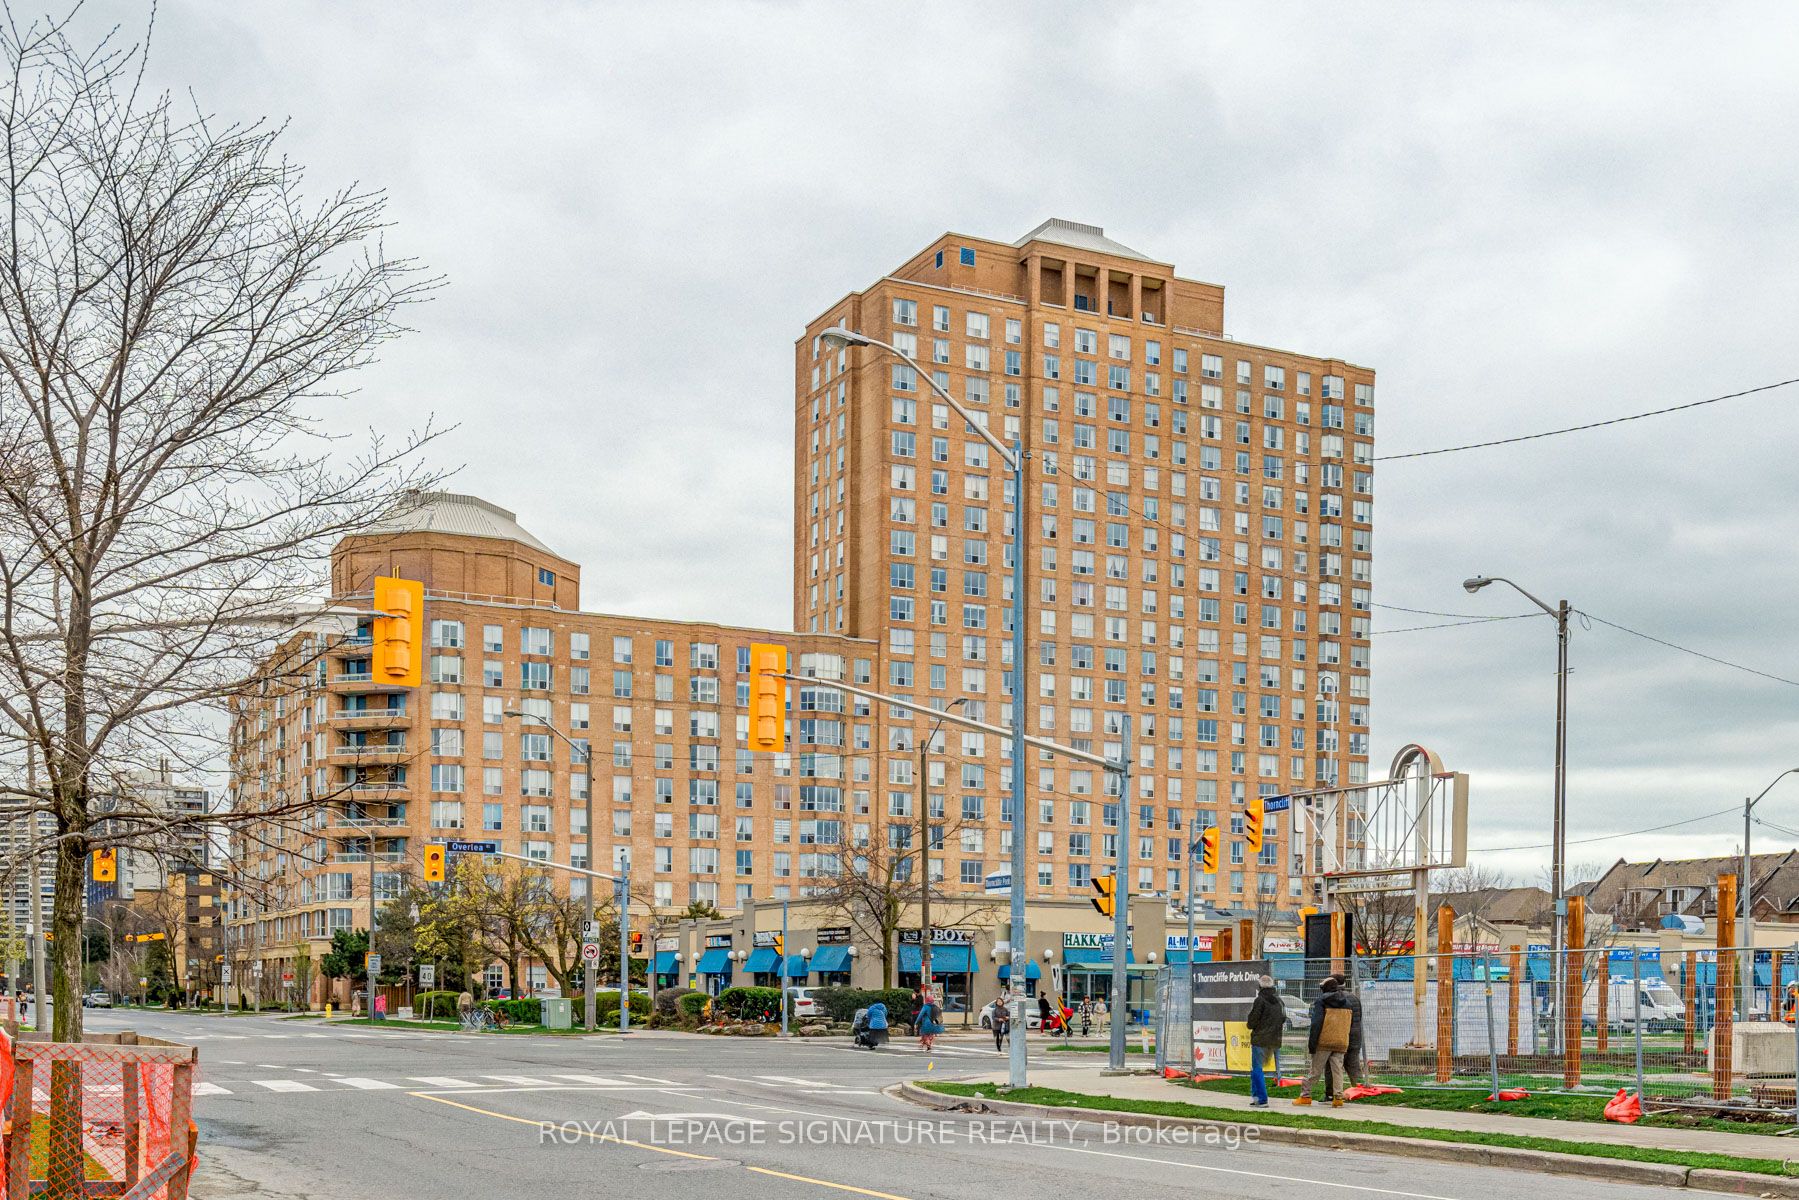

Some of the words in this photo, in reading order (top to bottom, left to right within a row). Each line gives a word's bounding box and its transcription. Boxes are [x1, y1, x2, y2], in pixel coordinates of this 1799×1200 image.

[452, 842, 484, 852] Overlea
[422, 972, 432, 980] 40
[1198, 971, 1228, 983] Thorncliffe
[1229, 971, 1243, 982] Park
[1245, 970, 1260, 982] Drive
